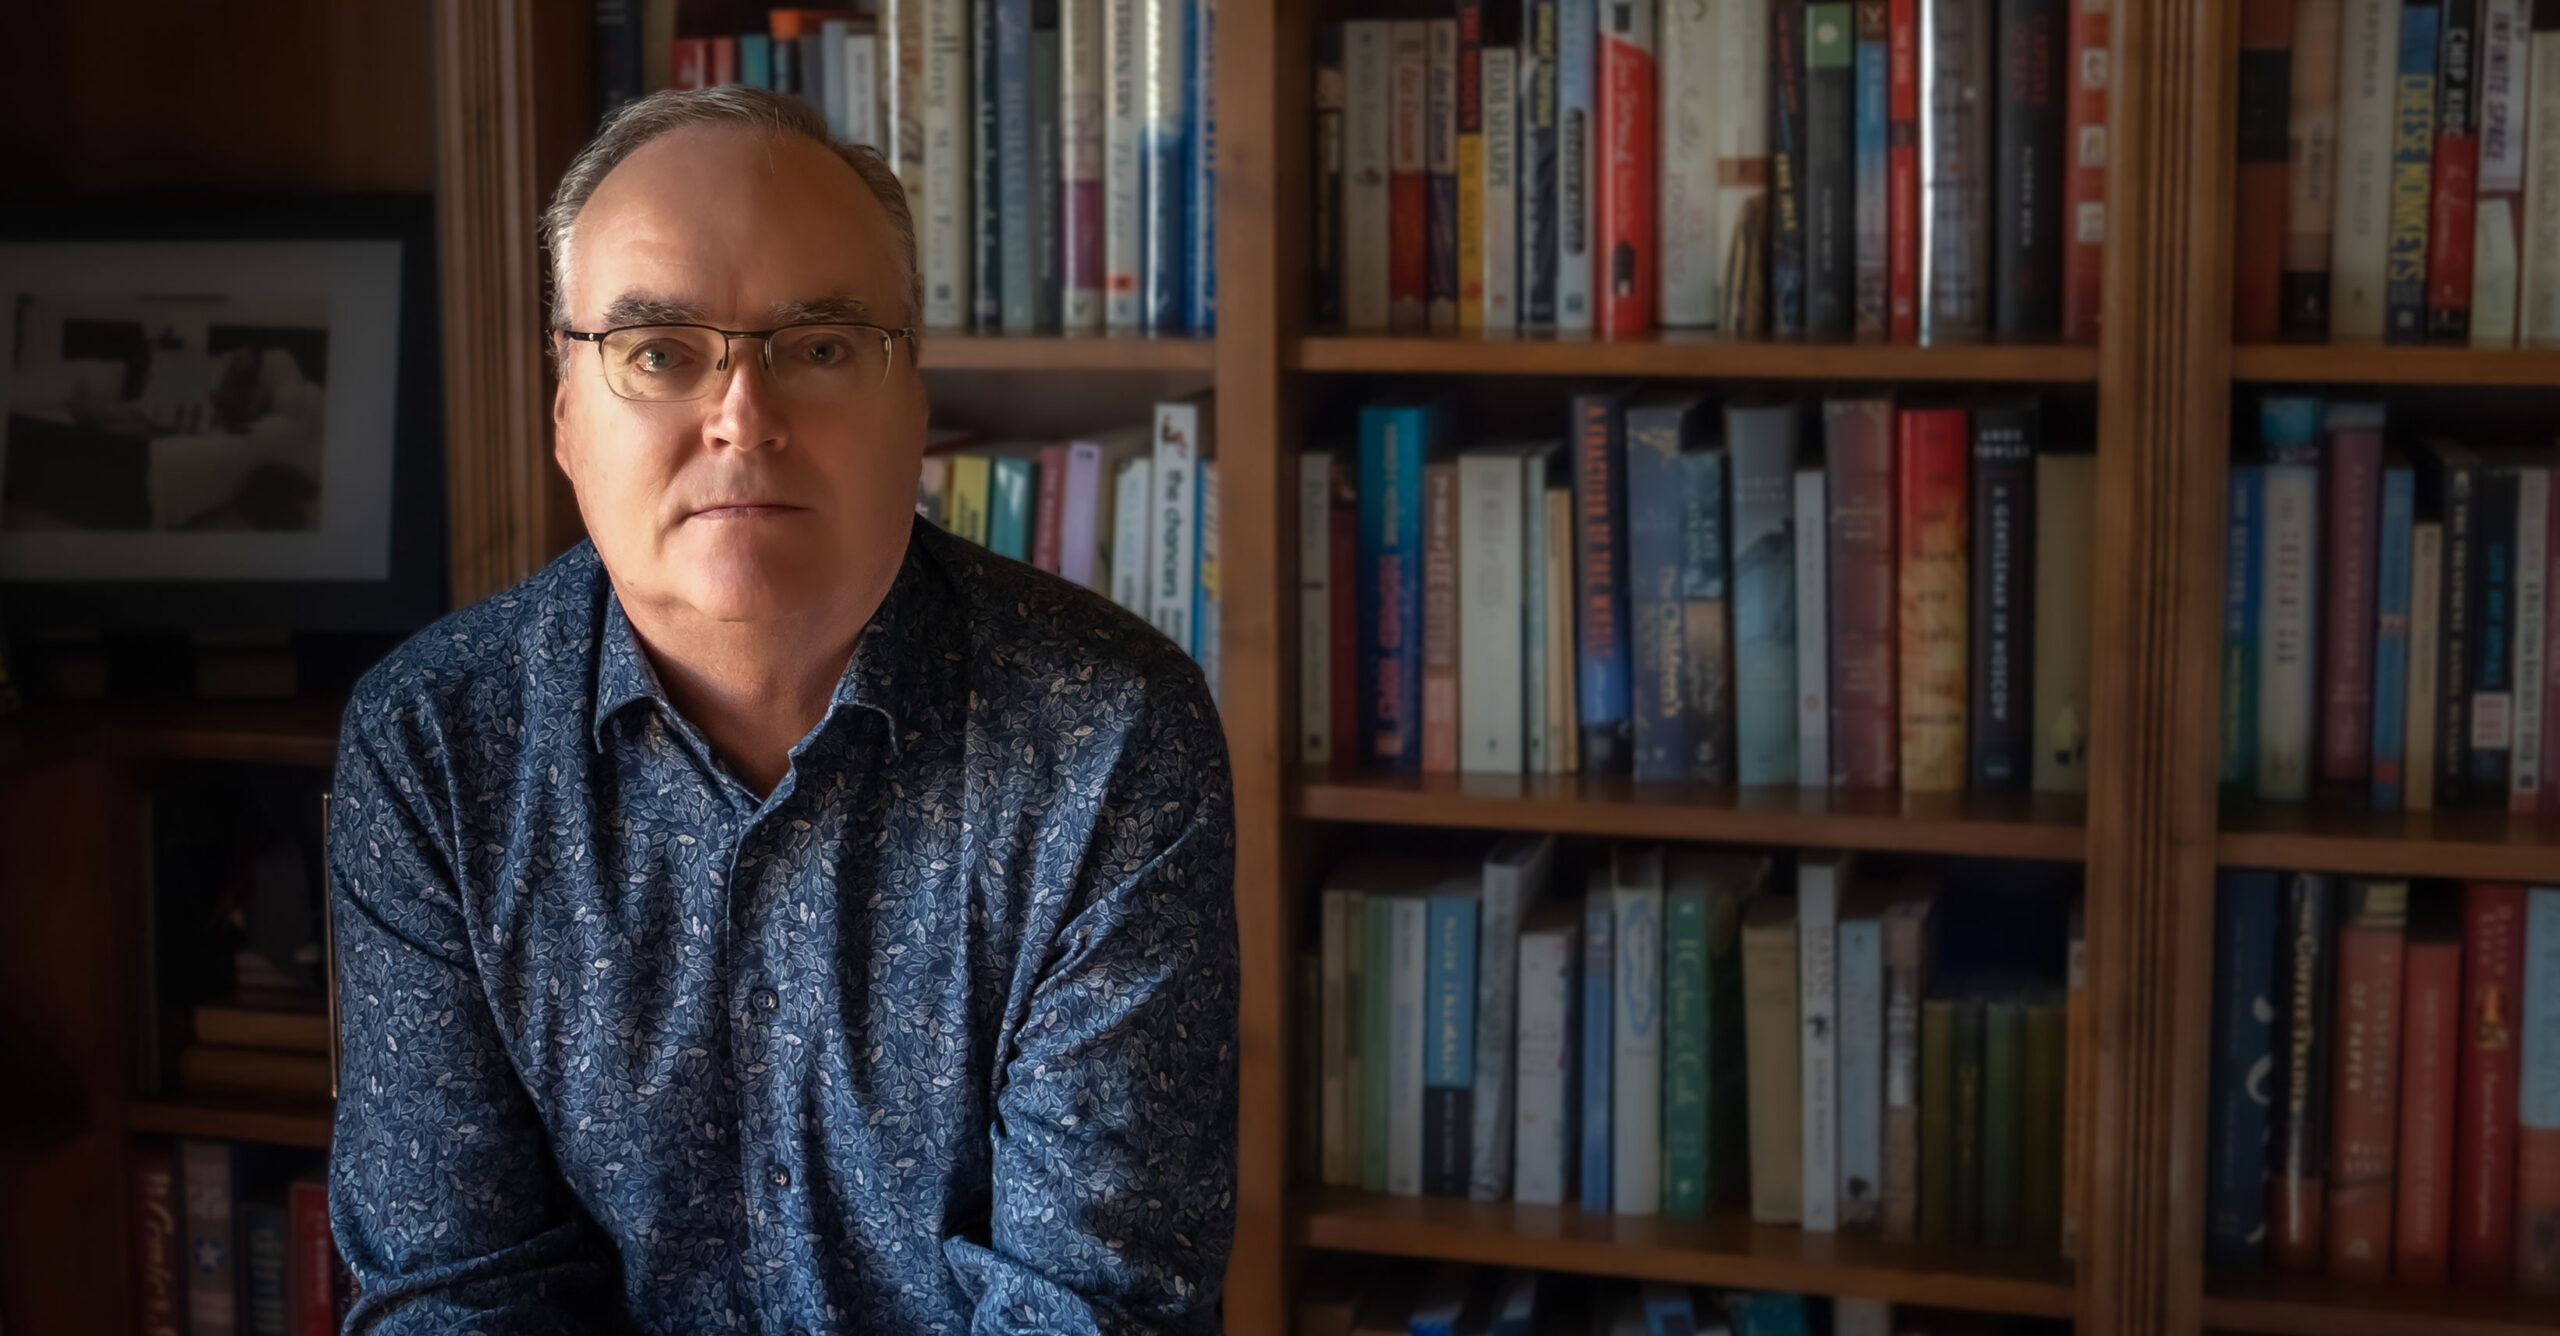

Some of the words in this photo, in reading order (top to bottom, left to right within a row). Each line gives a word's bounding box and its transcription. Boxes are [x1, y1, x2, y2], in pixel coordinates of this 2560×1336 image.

[1487, 57, 1510, 104] TOM
[2445, 28, 2469, 81] CHIP
[2487, 11, 2510, 94] INFINITE
[1003, 81, 1027, 194] MICHAEL
[1487, 108, 1510, 188] SHARPE
[2395, 75, 2434, 156] CHEESE
[2485, 100, 2509, 162] SPACE
[2388, 160, 2430, 283] MONKEYS
[1163, 469, 1185, 502] the
[1584, 423, 1609, 518] FRACTION
[1992, 485, 2008, 500] A
[1160, 507, 1185, 599] chancers
[2452, 504, 2467, 535] THE
[1426, 550, 1453, 588] LEE
[1587, 550, 1613, 586] THE
[1658, 565, 1678, 599] The
[1992, 503, 2009, 609] GENTLEMAN
[2450, 540, 2466, 632] TREATMENT
[1587, 593, 1614, 660] WHOLE
[1992, 613, 2007, 635] IN
[1657, 602, 1685, 720] Children's
[1991, 639, 2008, 722] MOSCOW
[2494, 906, 2513, 977] DAVID
[2350, 982, 2366, 1009] OF
[2346, 1021, 2366, 1094] PAPER
[2370, 977, 2392, 1116] CONSPIRACY
